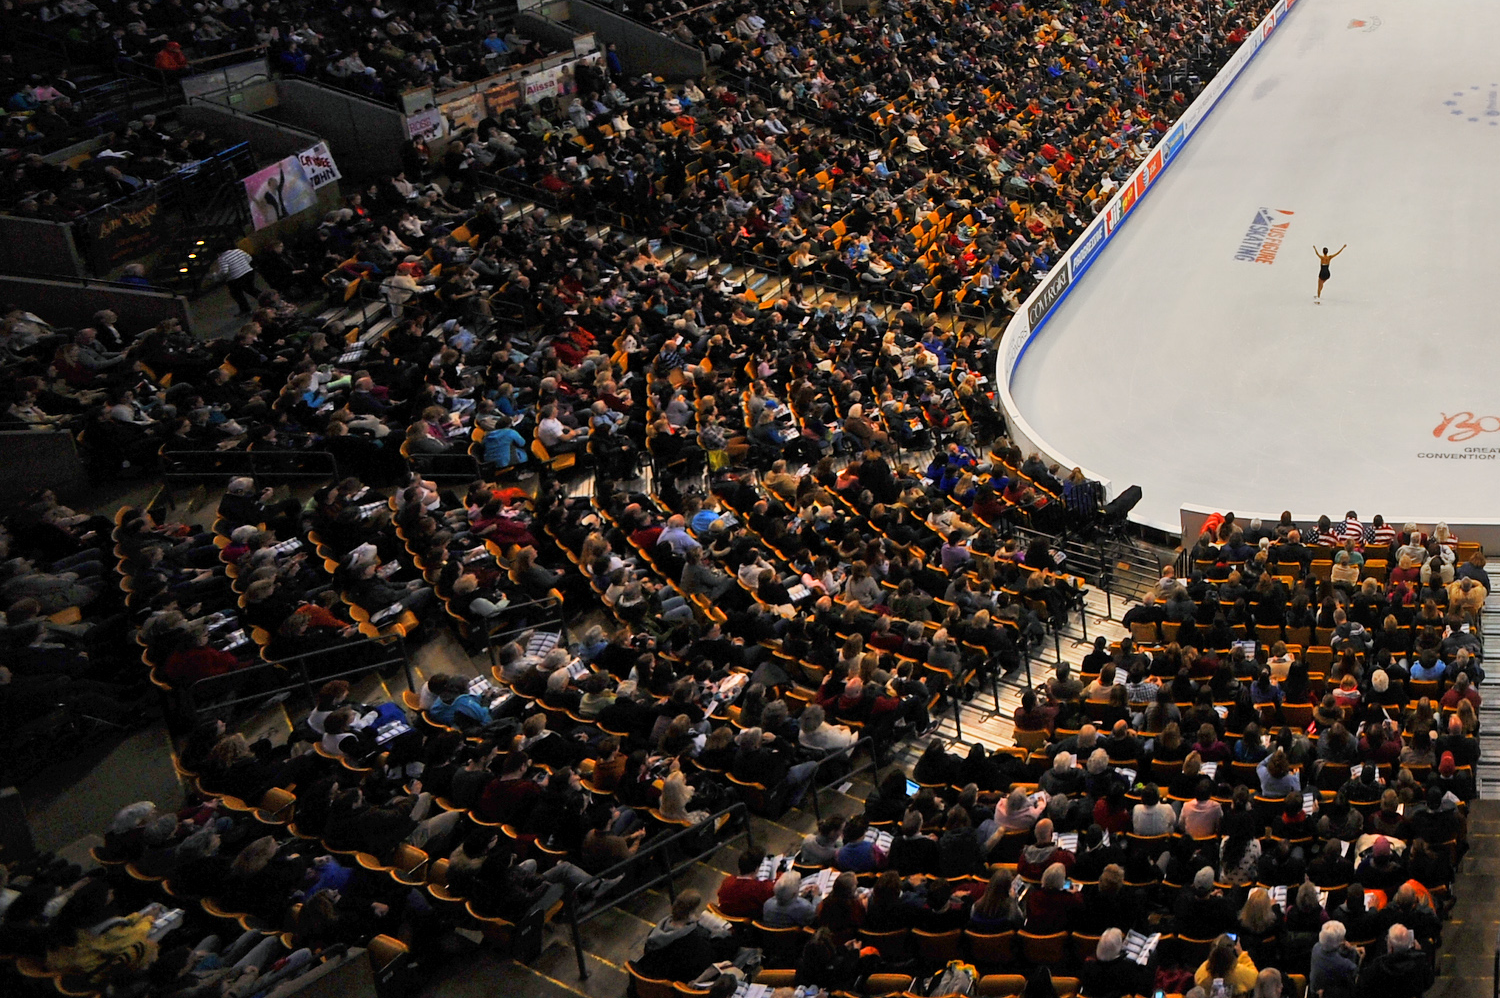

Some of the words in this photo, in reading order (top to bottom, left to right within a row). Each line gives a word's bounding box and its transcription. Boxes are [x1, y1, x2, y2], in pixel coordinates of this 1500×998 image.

[1234, 225, 1269, 262] SKATING
[1029, 273, 1068, 325] COVERGIRL
[1417, 452, 1496, 460] CONVENTION
